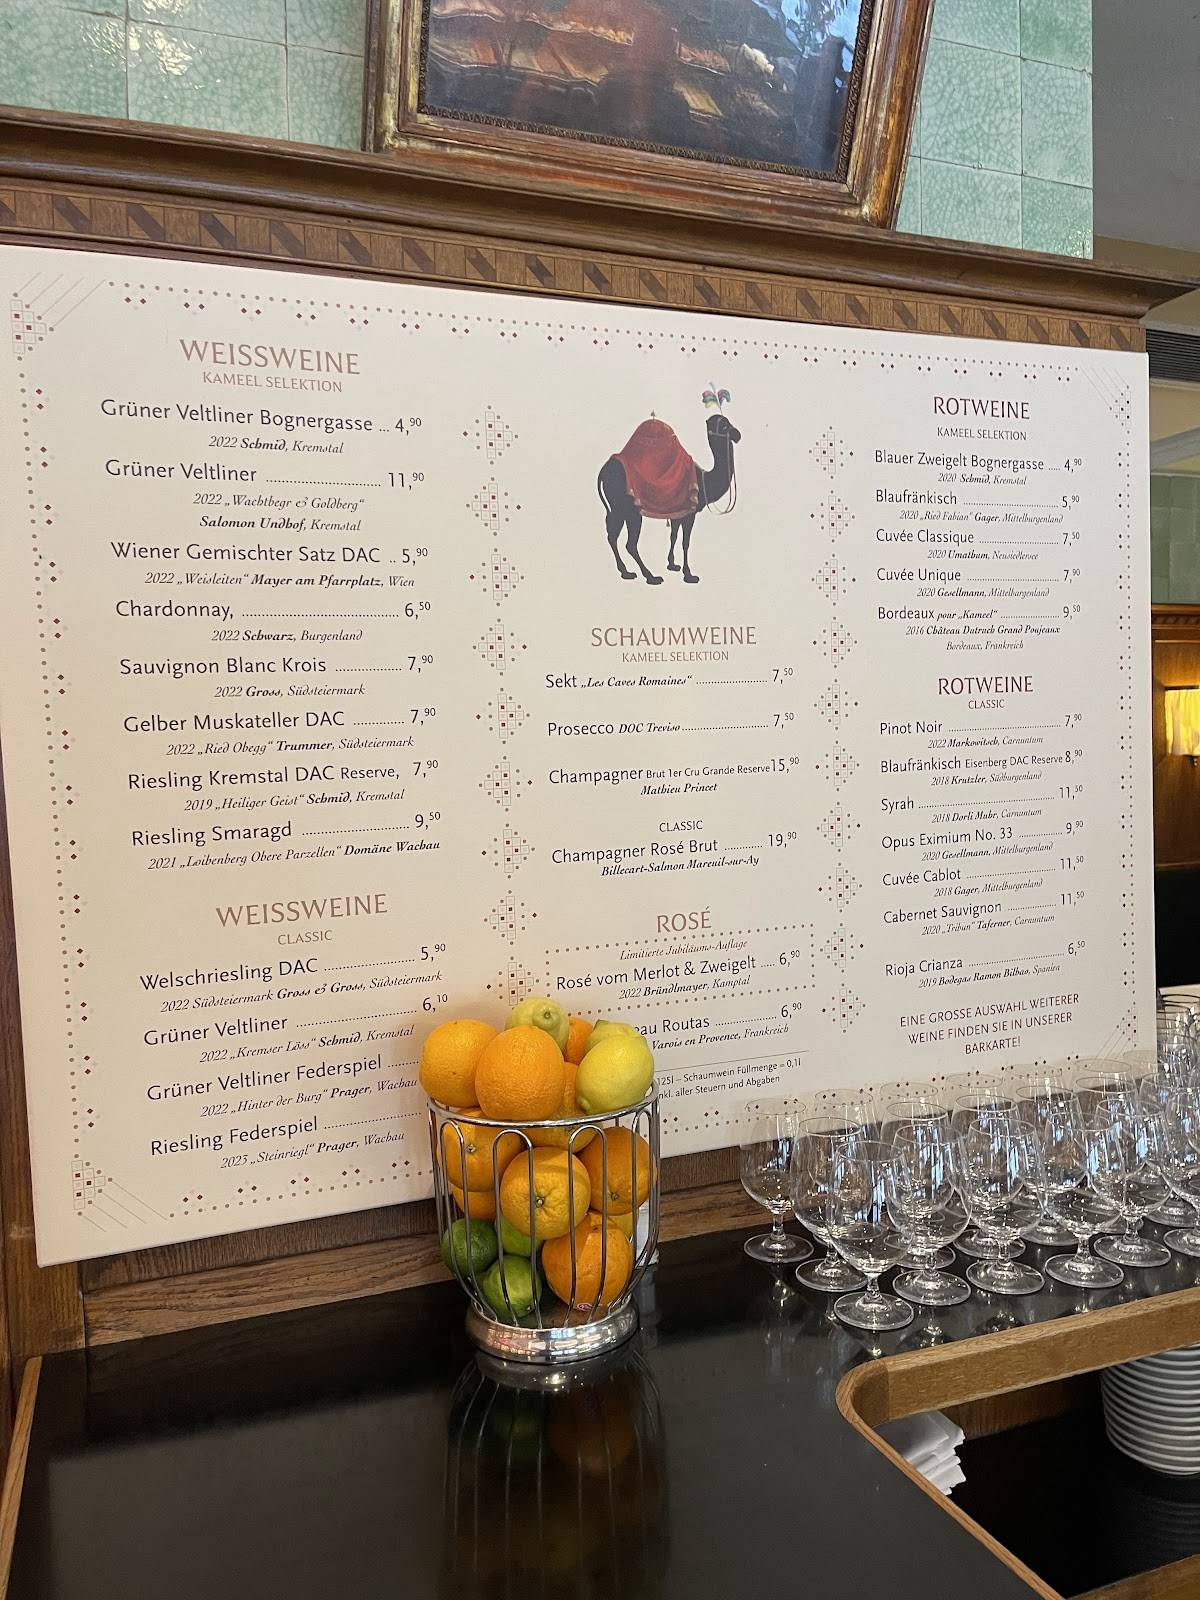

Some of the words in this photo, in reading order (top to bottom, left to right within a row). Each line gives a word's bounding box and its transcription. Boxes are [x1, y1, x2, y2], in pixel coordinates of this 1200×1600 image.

[179, 339, 360, 375] WEISSWEINE
[203, 371, 262, 387] KAMEEL
[265, 376, 342, 393] SELEKTION
[101, 399, 171, 419] Grüner
[176, 404, 254, 424] Veltliner
[260, 409, 372, 434] Bognergasse
[395, 417, 422, 436] 4,90
[934, 396, 1030, 420] ROTWEINE
[937, 426, 975, 438] KAMEEL
[977, 429, 1026, 441] SELEKTION
[875, 449, 914, 464] Blauer
[918, 452, 967, 471] Zweigelt
[971, 454, 1044, 473] Bognergasse
[1064, 458, 1082, 473] 4,90
[105, 459, 175, 478] Grüner
[180, 462, 257, 482] Veltliner
[388, 472, 424, 491] 11,90
[876, 488, 957, 505] Blaufränkisch
[1062, 495, 1080, 511] 5,90
[199, 515, 255, 528] Salomon
[260, 517, 306, 533] Undhof,
[310, 519, 362, 531] Kremstal
[876, 528, 913, 542] Cuvée
[917, 528, 974, 547] Classique
[1062, 531, 1080, 547] 7,50
[110, 542, 180, 559] Wiener
[186, 543, 293, 561] Gemischter
[299, 546, 336, 562] Satz
[342, 547, 380, 563] DAC
[402, 547, 428, 566] 5,90
[144, 572, 175, 584] 2022
[251, 574, 293, 588] Mayer
[318, 574, 384, 589] Pfarrplatz,
[389, 576, 415, 587] Wien
[877, 567, 914, 581] Cuvée
[918, 568, 961, 585] Unique
[1063, 568, 1081, 584] 7,90
[116, 599, 233, 622] Chardonnay,
[405, 601, 431, 620] 6,50
[878, 606, 934, 620] Bordeaux
[936, 613, 957, 622] pour
[958, 609, 998, 620] „Kameel“
[1063, 604, 1081, 620] 9,50
[591, 626, 757, 647] SCHAUMWEINE
[120, 658, 219, 679] Sauvignon
[227, 656, 276, 673] Blanc
[282, 657, 326, 672] Krois
[407, 654, 433, 673] 7,90
[622, 652, 668, 663] KAMEEL
[670, 650, 729, 662] SELEKTION
[546, 673, 577, 688] Sekt
[581, 677, 604, 688] „Les
[607, 677, 636, 687] Caves
[638, 675, 692, 686] Romaines“
[772, 667, 793, 685] 7,50
[938, 676, 1033, 695] ROTWEINE
[968, 699, 1005, 709] CLASSIC
[124, 714, 187, 732] Gelber
[194, 711, 300, 730] Muskateller
[306, 711, 345, 727] DAC
[410, 707, 436, 726] 7,90
[548, 722, 614, 736] Prosecco
[618, 723, 644, 734] DOC
[646, 722, 681, 732] Treviso
[773, 712, 794, 729] 7,50
[880, 722, 912, 735] Pinot
[916, 720, 943, 733] Noir
[1065, 713, 1082, 728] 7,90
[549, 768, 644, 786] Champagner
[646, 769, 665, 779] Brut
[668, 768, 682, 778] 1er
[684, 767, 700, 777] Cru
[702, 765, 735, 776] Grande
[737, 765, 770, 774] Reserve
[771, 756, 800, 774] 15,90
[881, 755, 961, 773] Blaufränkisch
[965, 757, 1007, 769] Eisenberg
[1010, 755, 1029, 766] DAC
[1031, 755, 1063, 765] Reserve
[1065, 749, 1083, 764] 8,90
[129, 771, 203, 792] Riesling
[209, 766, 288, 786] Kremstal
[295, 765, 335, 782] DAC
[341, 767, 399, 780] Reserve,
[413, 759, 439, 778] 7,90
[881, 796, 914, 814] Syrah
[1059, 784, 1083, 800] 11,50
[132, 827, 206, 847] Riesling
[212, 820, 291, 842] Smaragd
[415, 811, 441, 830] 9,50
[659, 820, 703, 833] CLASSIC
[882, 836, 915, 852] Opus
[920, 831, 971, 846] Eximium
[975, 829, 996, 841] No.
[1000, 826, 1012, 839] 33
[1065, 820, 1084, 836] 9,90
[552, 847, 646, 864] Champagner
[651, 840, 684, 856] Rosé
[689, 839, 718, 853] Brut
[768, 831, 797, 848] 19,90
[882, 871, 920, 886] Cuvée
[923, 867, 961, 883] Cablot
[1060, 855, 1084, 871] 11,50
[216, 893, 388, 927] WEISSWEINE
[657, 906, 712, 933] ROSÉ
[883, 907, 937, 924] Cabernet
[941, 903, 1001, 919] Sauvignon
[1061, 890, 1085, 907] 11,50
[278, 930, 332, 945] CLASSIC
[140, 964, 273, 990] Welschriesling
[279, 958, 318, 976] DAC
[421, 943, 446, 962] 5,90
[557, 973, 592, 990] Rosé
[596, 973, 628, 986] vom
[634, 964, 680, 981] Merlot
[684, 961, 696, 976] &
[700, 955, 756, 975] Zweigelt
[779, 949, 800, 967] 6,90
[886, 962, 915, 978] Rioja
[919, 959, 963, 972] Crianza
[1068, 940, 1085, 956] 6,50
[144, 1028, 209, 1045] Grüner
[214, 1017, 288, 1037] Veltliner
[422, 993, 448, 1013] 6,10
[663, 1017, 710, 1033] Routas
[781, 1002, 802, 1019] 6,90
[900, 1014, 925, 1027] EINE
[928, 1007, 972, 1023] GROSSE
[974, 1001, 1028, 1017] AUSWAHL
[1029, 993, 1079, 1009] WEITERER
[908, 1029, 944, 1044] WEINE
[948, 1023, 989, 1039] FINDEN
[992, 1020, 1008, 1033] SIE
[1011, 1019, 1022, 1030] IN
[1025, 1011, 1072, 1028] UNSERER
[965, 1036, 1020, 1055] BARKARTE!
[147, 1082, 212, 1100] Grüner
[217, 1070, 291, 1091] Veltliner
[297, 1054, 381, 1080] Federspiel
[683, 1068, 735, 1083] Schaumwein
[737, 1063, 778, 1074] Füllmenge
[786, 1058, 801, 1068] 0,1l
[675, 1087, 693, 1097] aller
[695, 1084, 726, 1094] Steuern
[728, 1079, 744, 1089] und
[745, 1075, 780, 1088] Abgaben
[151, 1133, 223, 1156] Riesling
[230, 1115, 317, 1145] Federspiel
